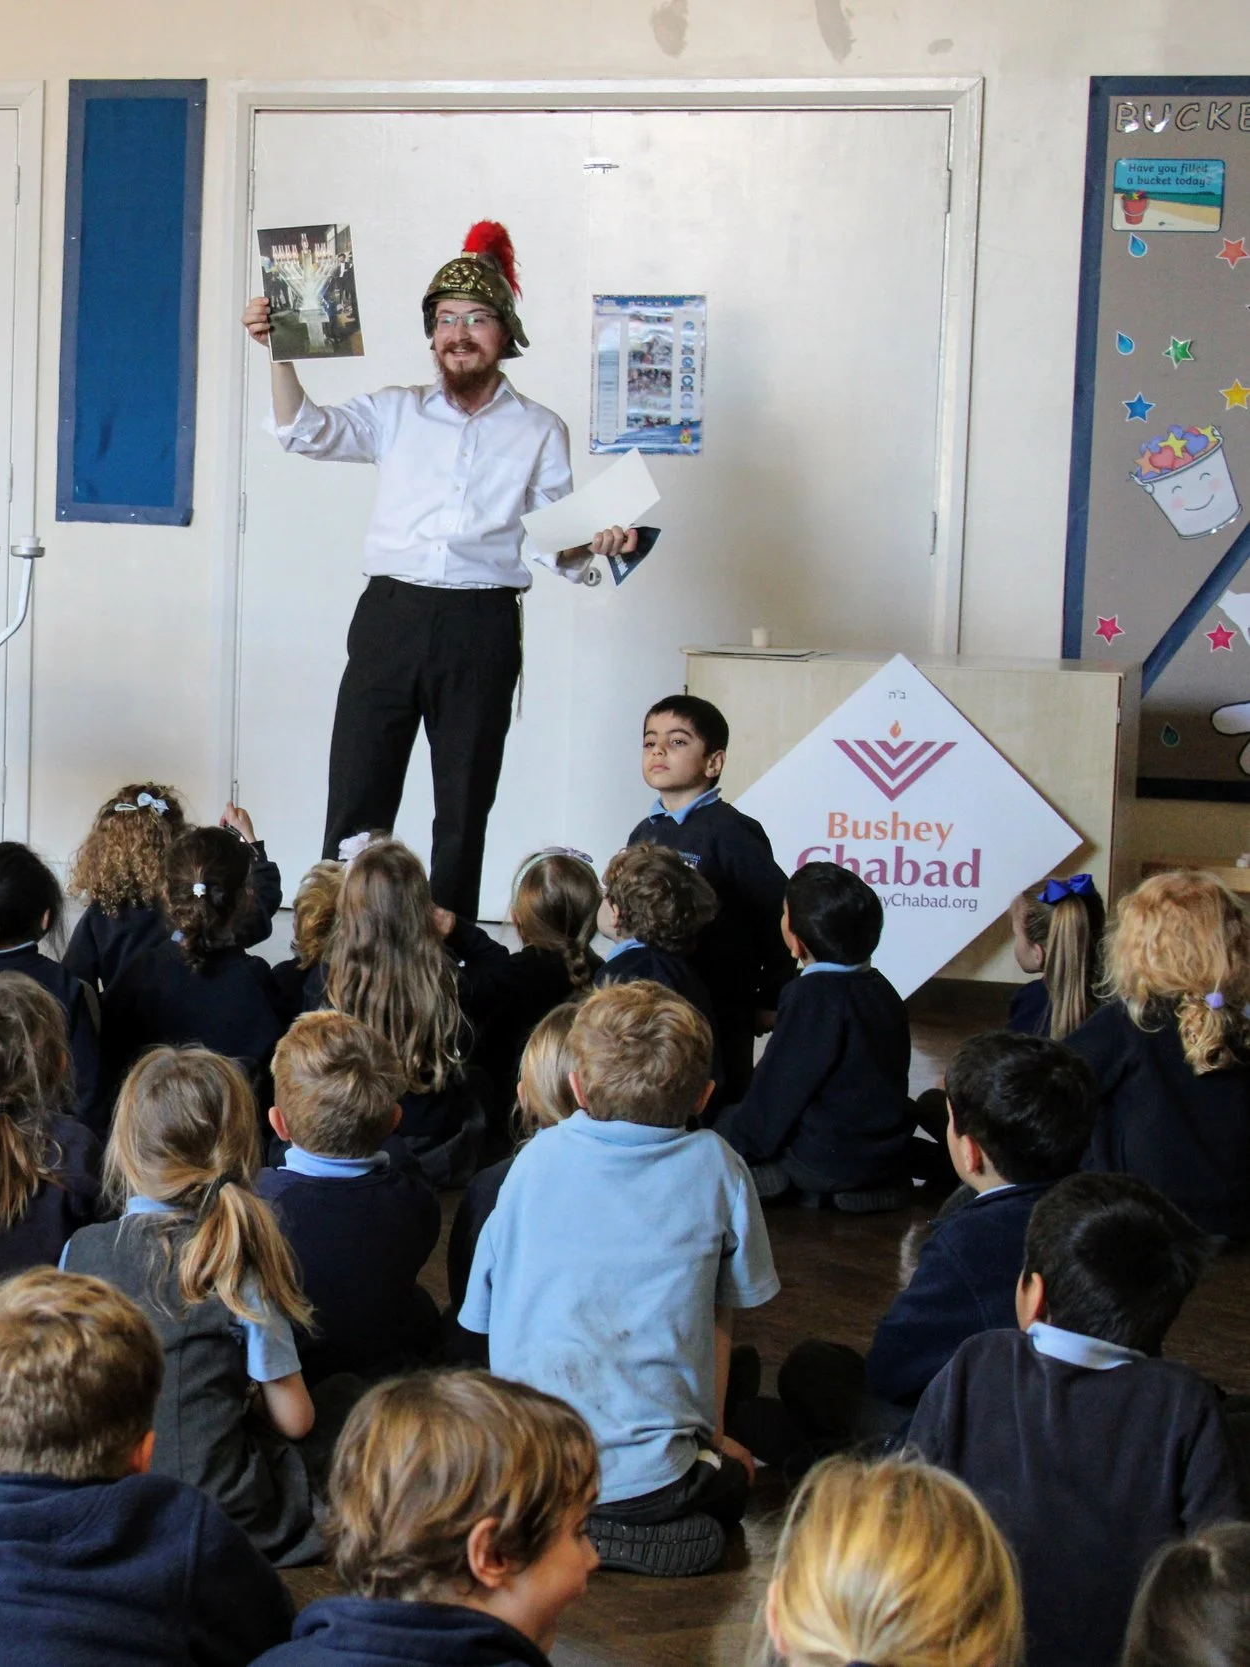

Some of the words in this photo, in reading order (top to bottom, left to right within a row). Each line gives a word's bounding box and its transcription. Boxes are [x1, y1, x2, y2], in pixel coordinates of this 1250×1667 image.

[1128, 163, 1155, 173] Have
[1158, 166, 1177, 175] you
[1181, 163, 1208, 175] filled
[1137, 176, 1171, 185] bucket
[827, 811, 954, 851] Bushey
[879, 892, 978, 912] yChabad.org
